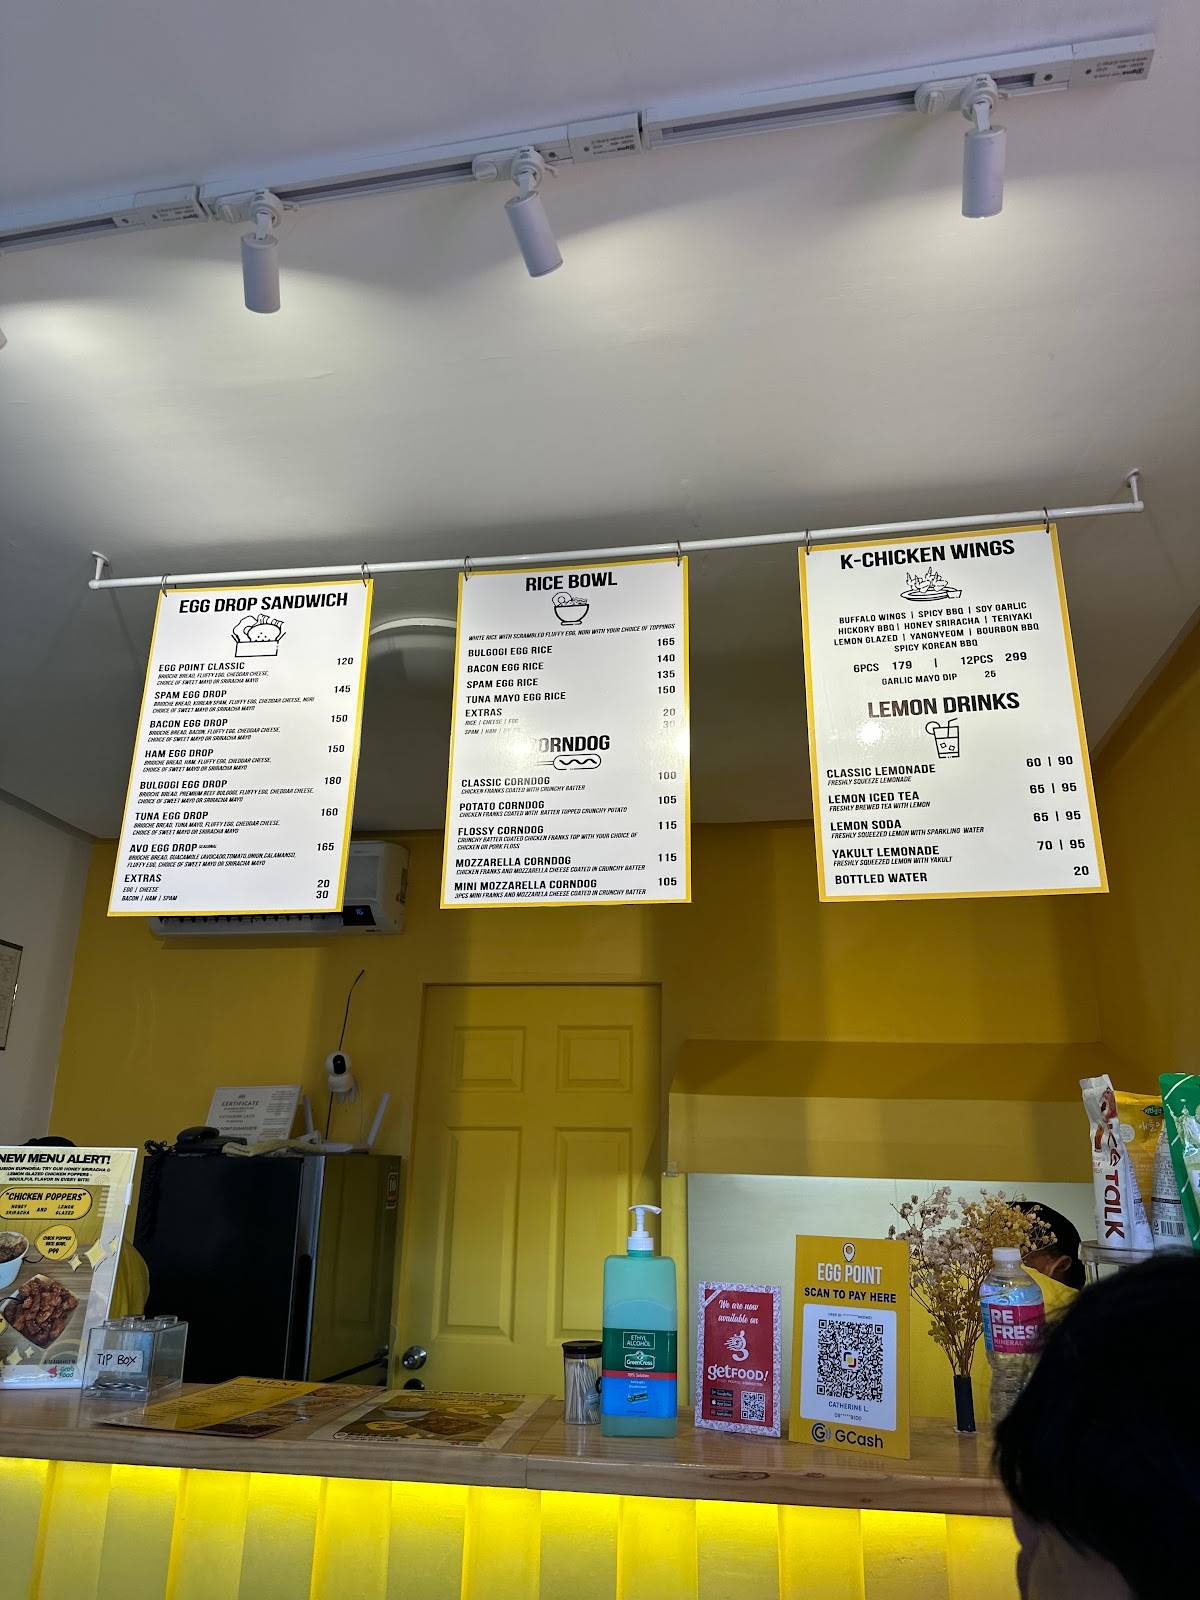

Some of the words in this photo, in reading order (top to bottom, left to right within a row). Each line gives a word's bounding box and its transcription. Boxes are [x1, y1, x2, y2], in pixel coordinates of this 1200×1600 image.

[841, 546, 946, 570] K-CHICKEN
[950, 539, 1015, 560] WINGS
[526, 576, 564, 592] RICE
[568, 572, 618, 589] BOWL
[179, 599, 211, 614] EGG
[214, 598, 258, 612] DROP
[261, 592, 348, 610] SANDWICH
[839, 615, 876, 624] BUFFALO
[878, 612, 907, 621] WINGS
[918, 609, 943, 618] SPICY
[946, 608, 964, 616] BBQ
[976, 605, 993, 613] SOY
[996, 602, 1027, 612] GARLIC
[839, 626, 875, 635] HICKORY
[878, 624, 895, 632] BBQ
[904, 621, 933, 630] HONEY
[936, 617, 980, 628] SRIRACHA
[992, 613, 1033, 623] TERIYAKI
[834, 637, 863, 646] LEMON
[866, 635, 898, 644] GLAZED
[910, 629, 964, 640] YANGNYEOM
[977, 625, 1019, 635] BOURBON
[1021, 623, 1040, 631] BBQ
[658, 638, 675, 647] 165
[468, 648, 507, 657] BULGOGI
[511, 647, 528, 655] EGG
[531, 646, 553, 655] RICE
[159, 664, 176, 672] EGG
[178, 664, 205, 672] POINT
[208, 662, 245, 671] CLASSIC
[854, 663, 879, 673] 6PCS
[893, 661, 912, 670] 179
[961, 654, 994, 665] 12PCS
[1005, 652, 1027, 662] 299
[882, 677, 913, 686] GARLIC
[916, 675, 940, 683] MAYO
[943, 673, 958, 681] DIP
[658, 686, 676, 694] 150
[467, 696, 491, 704] TUNA
[494, 694, 520, 703] MAYO
[524, 693, 541, 702] EGG
[544, 692, 566, 701] RICE
[868, 698, 938, 718] LEMON
[943, 692, 1020, 714] DRINKS
[466, 708, 502, 717] EXTRAS
[664, 708, 676, 717] 20
[150, 720, 181, 728] BACON
[183, 720, 201, 728] EGG
[204, 719, 228, 727] DROP
[331, 715, 348, 723] 150
[534, 735, 610, 752] ORNDOG
[1027, 758, 1042, 768] 60
[1058, 756, 1073, 766] 90
[659, 772, 676, 780] 100
[827, 768, 872, 778] CLASSIC
[875, 764, 936, 776] LEMONADE
[140, 781, 179, 790] BULGOGI
[182, 781, 200, 789] EGG
[202, 780, 228, 788] DROP
[325, 777, 342, 785] 180
[462, 778, 502, 788] CLASSIC
[504, 777, 550, 786] CORNDOG
[1030, 784, 1045, 794] 65
[1062, 783, 1077, 792] 95
[829, 794, 866, 804] LEMON
[870, 792, 895, 802] ICED
[898, 791, 920, 801] TEA
[458, 827, 495, 836] FLOSSY
[498, 826, 544, 835] CORNDOG
[659, 821, 677, 830] 115
[130, 844, 149, 853] AVO
[151, 844, 170, 853] EGG
[172, 844, 198, 852] DROP
[317, 843, 334, 851] 165
[1037, 841, 1053, 851] 70
[1070, 839, 1086, 849] 95
[659, 853, 677, 862] 115
[832, 848, 874, 859] YAKULT
[877, 846, 940, 857] LEMONADE
[456, 858, 521, 868] MOZZARELLA
[524, 856, 571, 866] CORNDOG
[1074, 866, 1089, 876] 20
[124, 874, 162, 883] EXTRAS
[317, 880, 330, 888] 20
[659, 877, 677, 886] 105
[836, 874, 885, 885] BOTTLED
[888, 873, 928, 883] WATER
[455, 882, 477, 891] MINI
[480, 881, 546, 891] MOZZARELLA
[550, 880, 597, 889] CORNDOG
[316, 891, 329, 899] 30
[0, 1153, 26, 1163] NEW
[27, 1154, 65, 1164] MENU
[67, 1154, 111, 1164] ALERT!
[6, 1192, 44, 1201] "CHICKEN
[45, 1192, 86, 1201] POPPERS"
[817, 1262, 842, 1282] EGG
[845, 1264, 883, 1285] POINT
[804, 1287, 830, 1298] SCAN
[833, 1289, 846, 1299] TO
[848, 1290, 866, 1301] PAY
[870, 1292, 896, 1304] HERE
[719, 1299, 730, 1309] We
[732, 1302, 743, 1310] are
[744, 1303, 759, 1311] now
[718, 1313, 748, 1324] available
[750, 1317, 759, 1325] on
[990, 1308, 1014, 1324] RE
[992, 1323, 1040, 1340] FRES
[97, 1353, 112, 1366] TIP
[828, 1400, 862, 1412] CATHERINE
[835, 1429, 884, 1449] GCash
